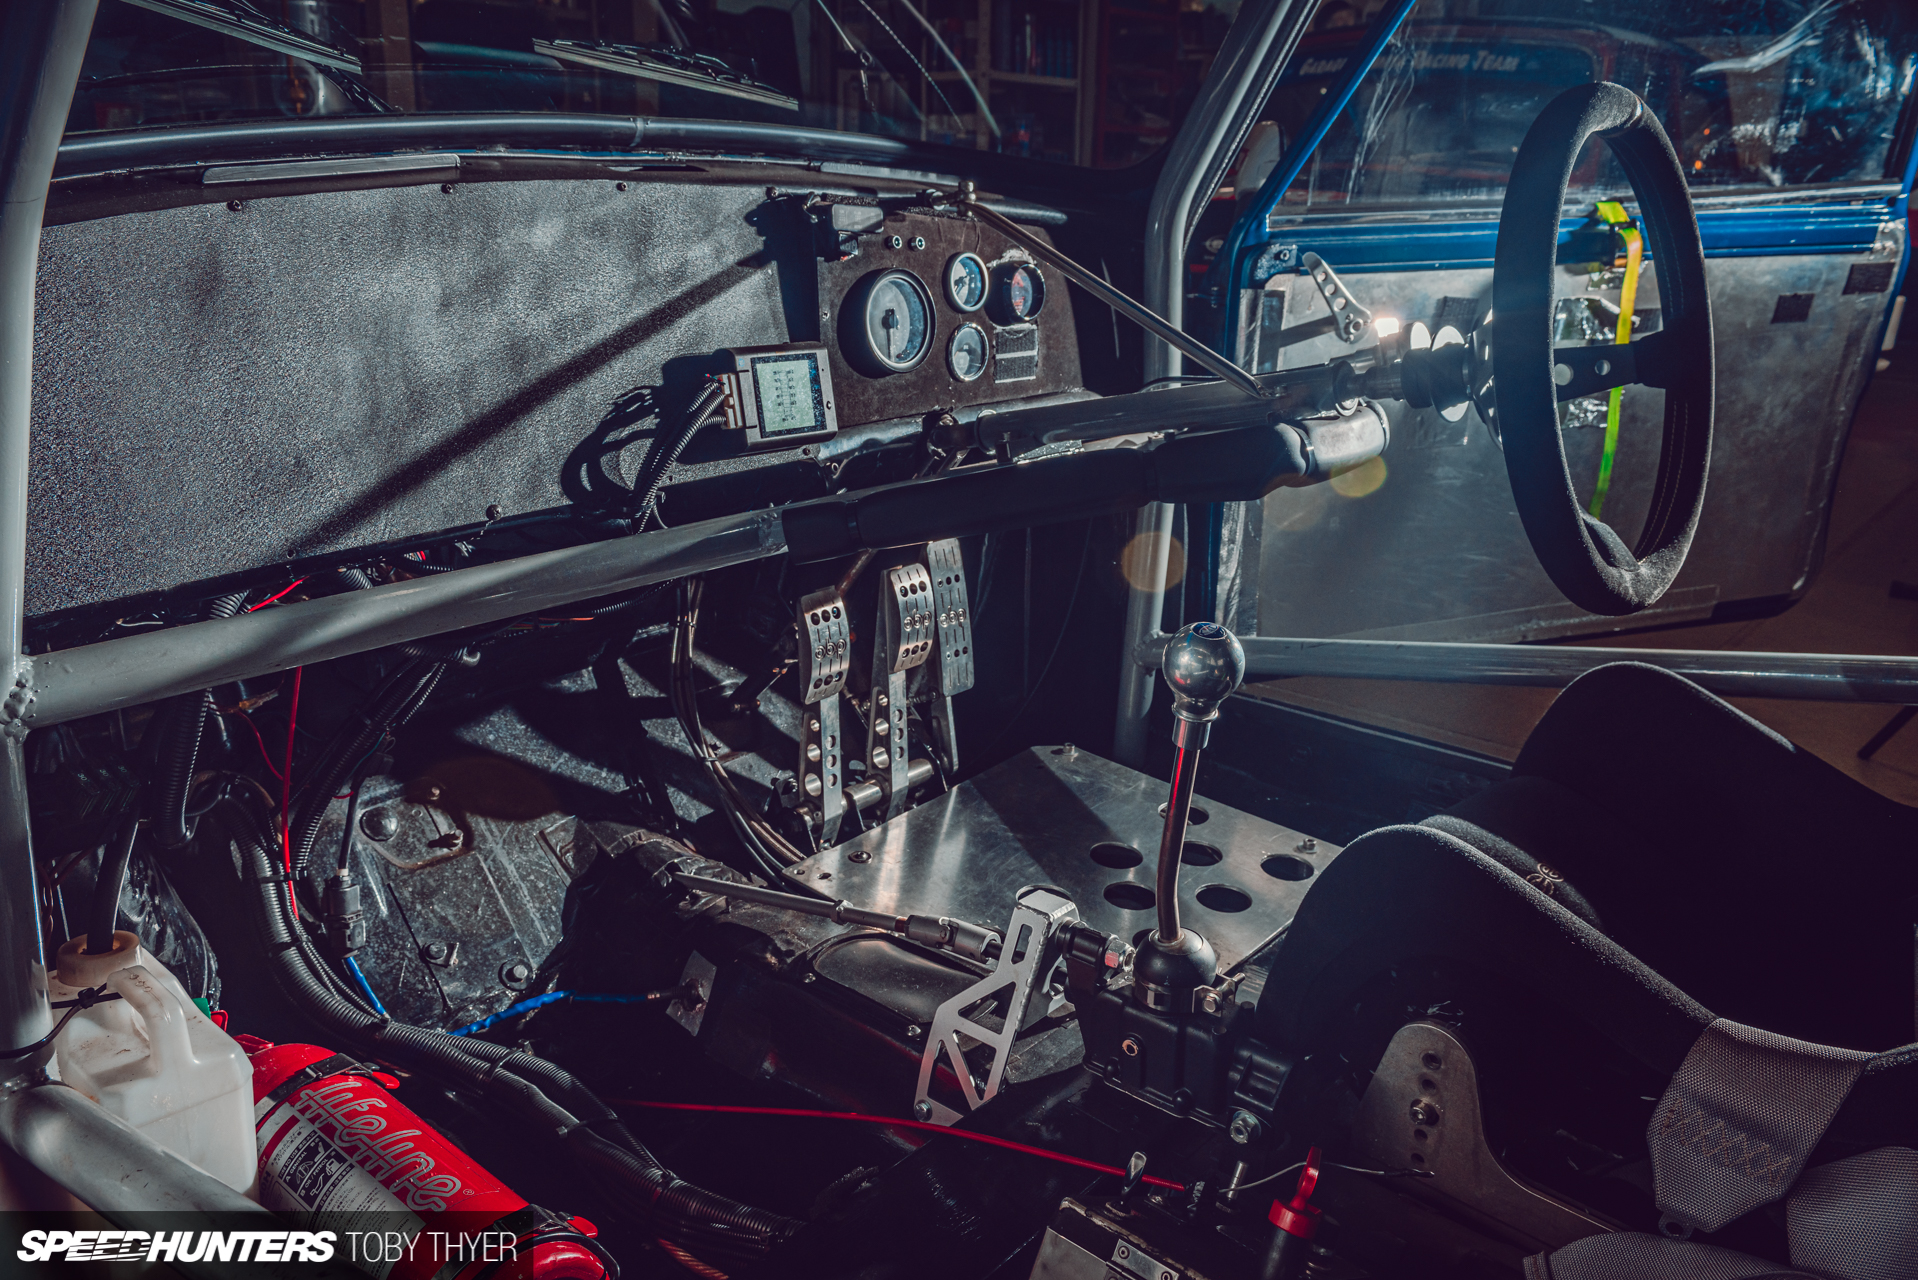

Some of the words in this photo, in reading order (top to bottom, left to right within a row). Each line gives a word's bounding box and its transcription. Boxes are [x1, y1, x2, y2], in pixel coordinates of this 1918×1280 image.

[815, 638, 847, 661] obp
[99, 769, 109, 777] 30
[117, 765, 128, 773] 30
[77, 773, 88, 781] 30
[290, 1149, 298, 1159] USE
[290, 1151, 307, 1174] GENERAL
[304, 1178, 312, 1188] OIL
[313, 1158, 328, 1176] PETROL
